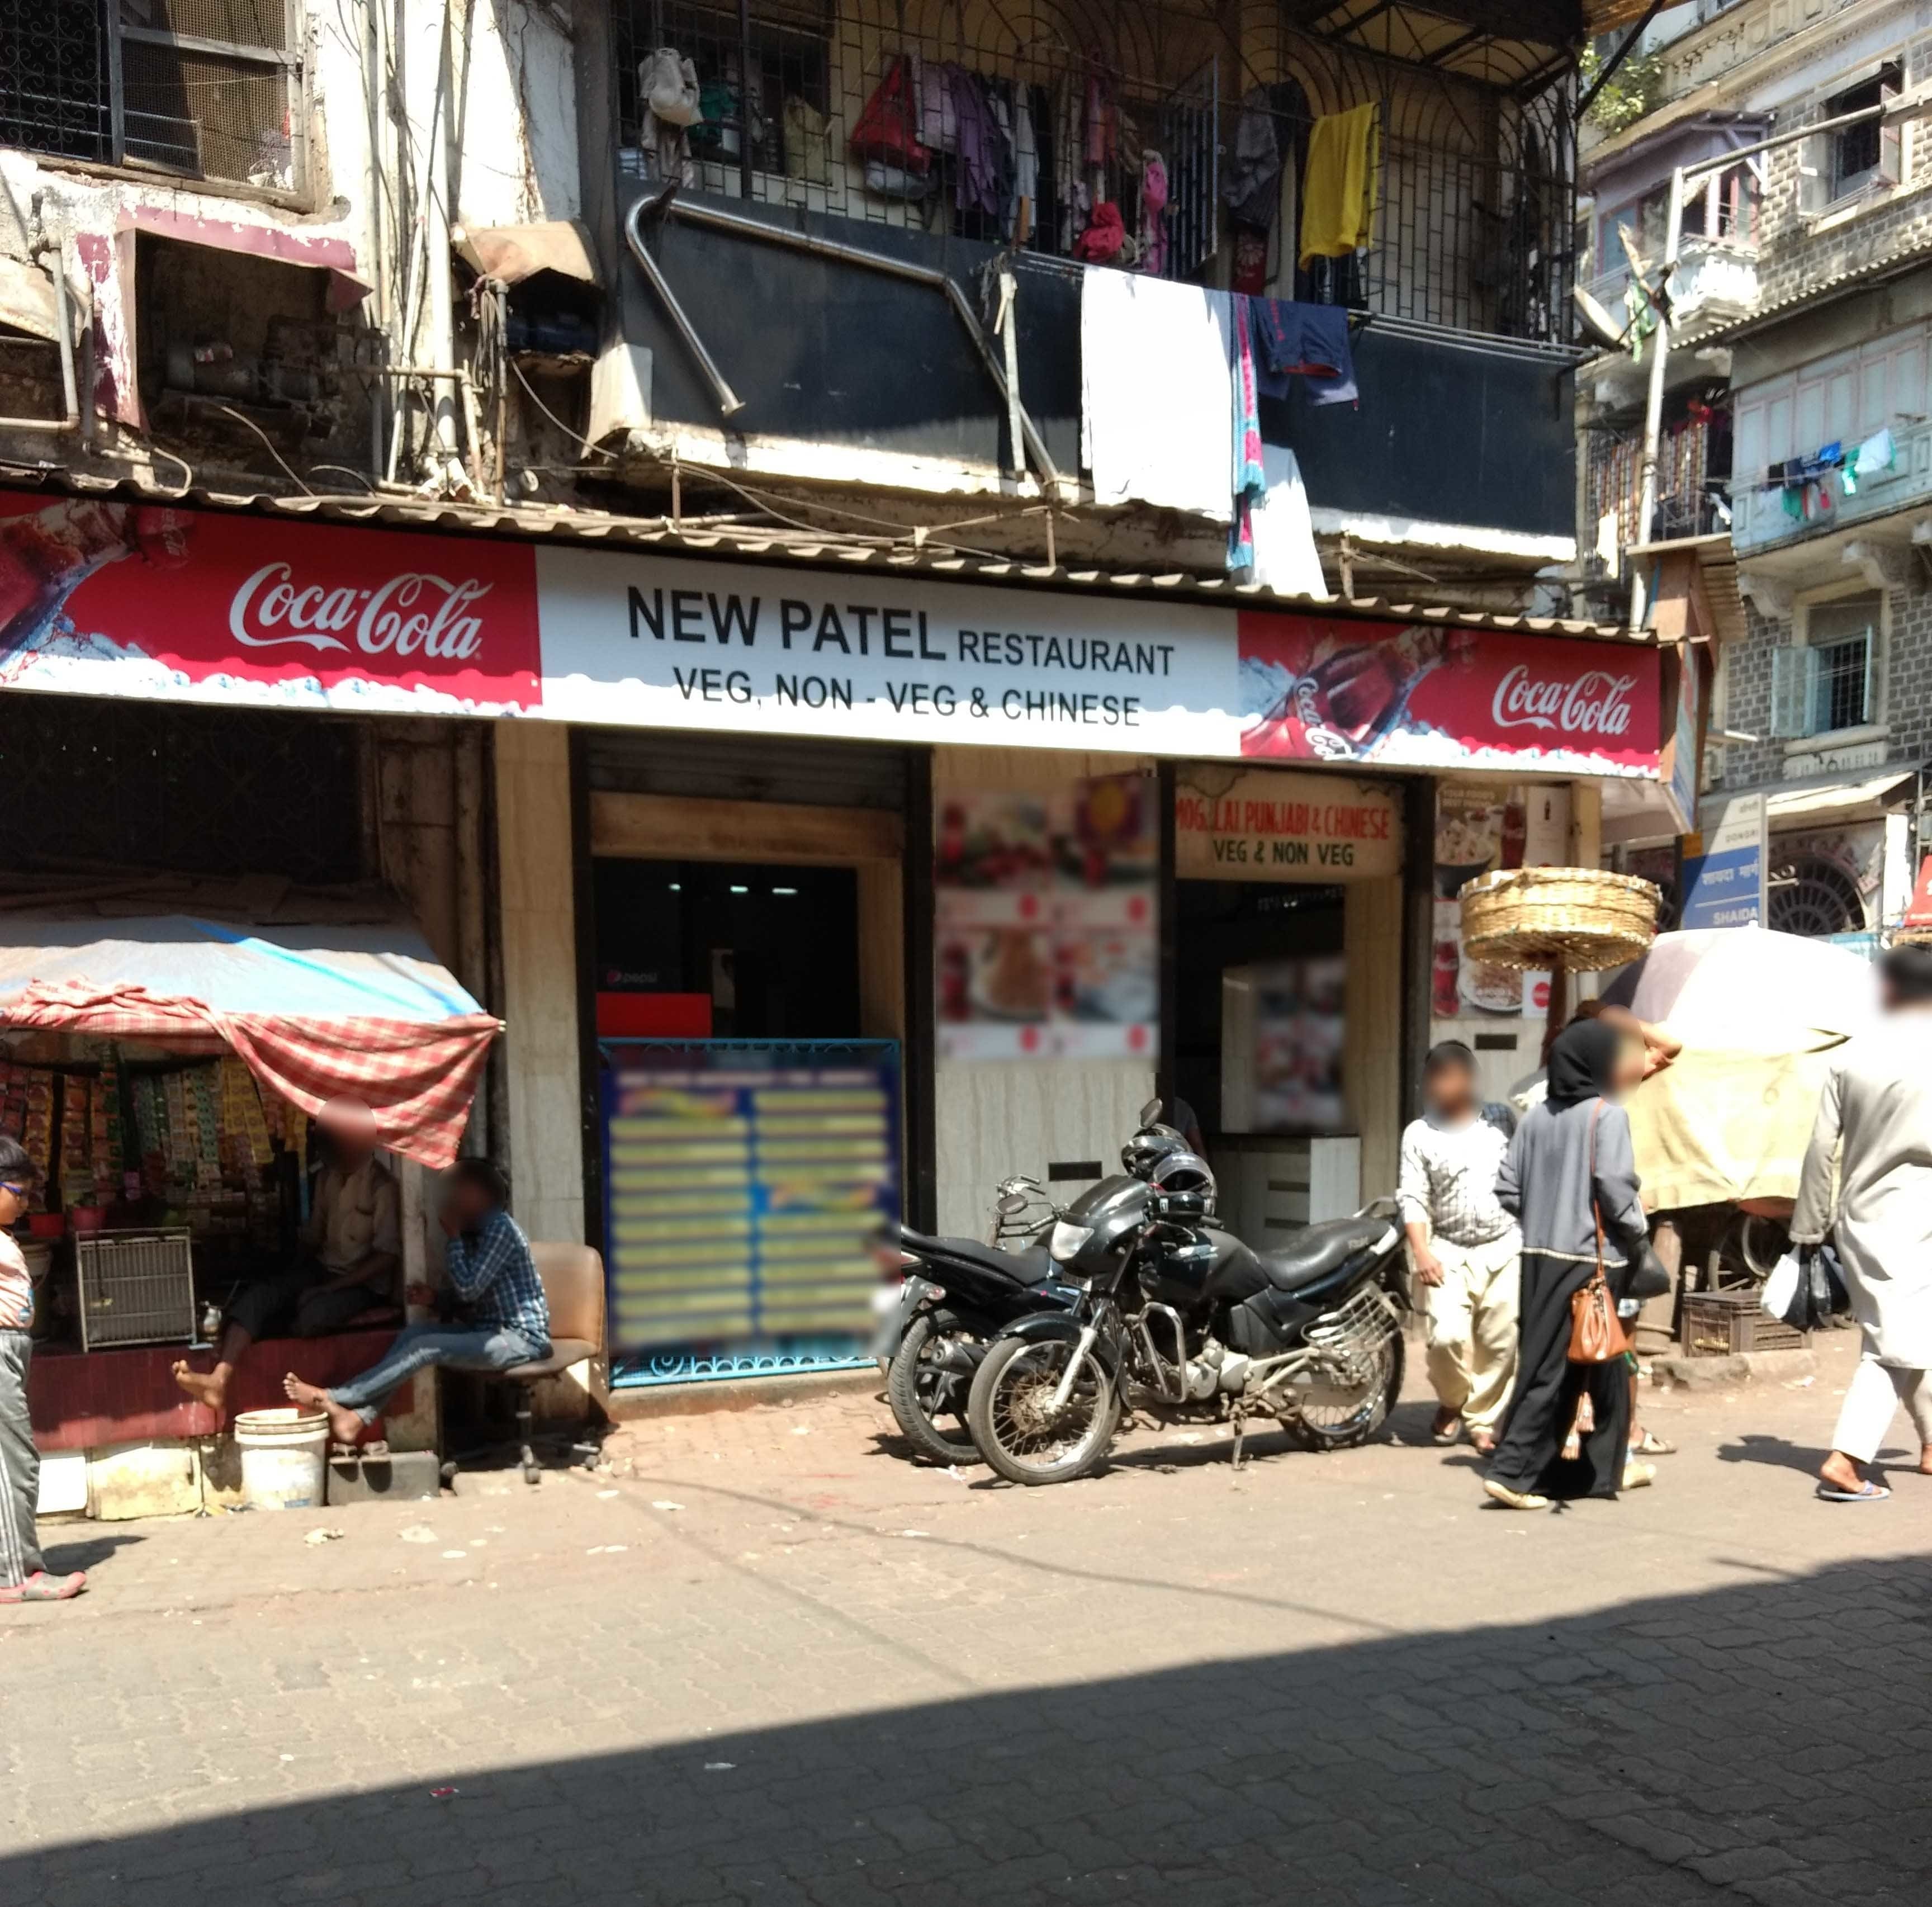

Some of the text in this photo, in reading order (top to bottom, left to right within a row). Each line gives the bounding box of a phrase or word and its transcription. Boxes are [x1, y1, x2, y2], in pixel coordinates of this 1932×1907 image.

[229, 561, 494, 660] Coca-Cola
[627, 585, 1175, 676] NEW PATEL RESTAURANT
[673, 666, 762, 711] VEG,
[776, 674, 852, 711] NON
[886, 681, 956, 717] VEG
[969, 687, 989, 718] &
[1002, 689, 1141, 727] CHINESE
[1492, 665, 1639, 735] Coca-Cola
[1244, 800, 1310, 837] PUNJABI
[1324, 805, 1390, 840] CHINESE
[1213, 840, 1355, 867] VEG & NON VEG
